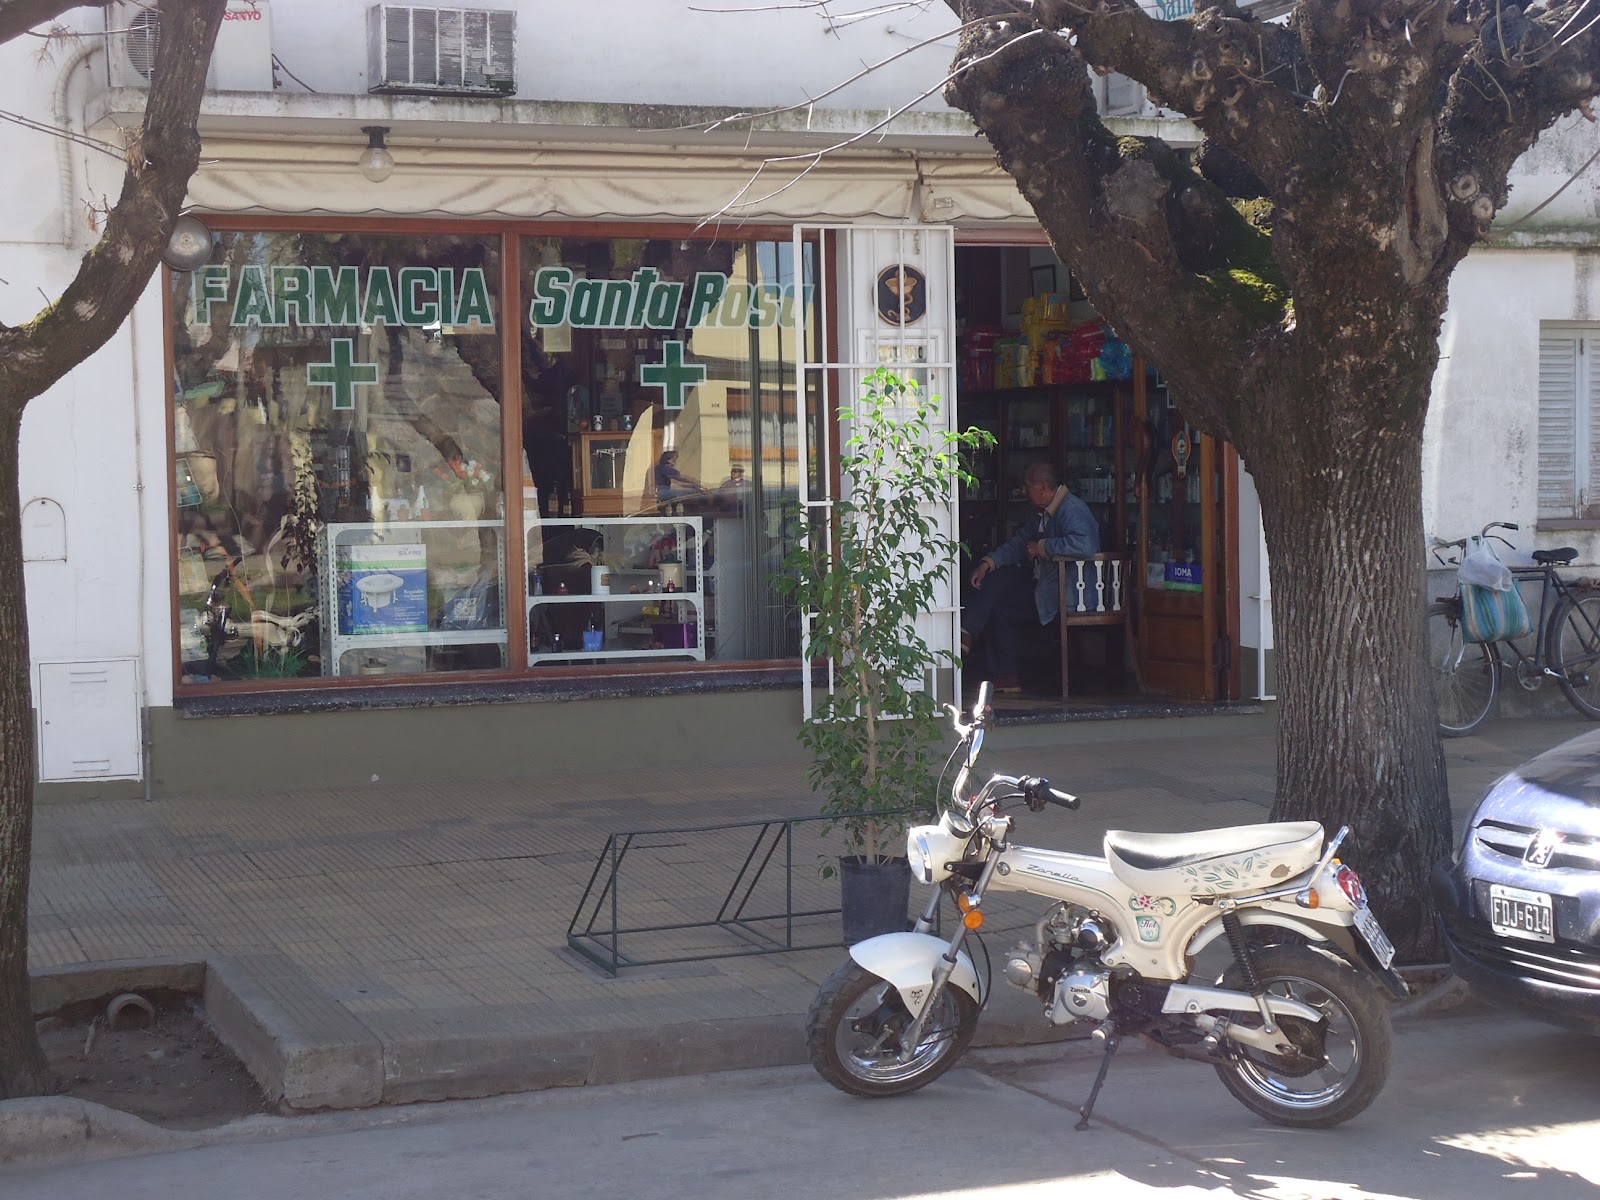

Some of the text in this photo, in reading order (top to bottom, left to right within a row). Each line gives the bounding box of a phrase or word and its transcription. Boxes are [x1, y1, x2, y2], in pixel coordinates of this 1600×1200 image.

[224, 11, 261, 20] SANYO
[195, 265, 815, 330] FARMACIA Santa Rosa
[1174, 567, 1192, 577] IOMA
[1027, 864, 1084, 883] Zanella
